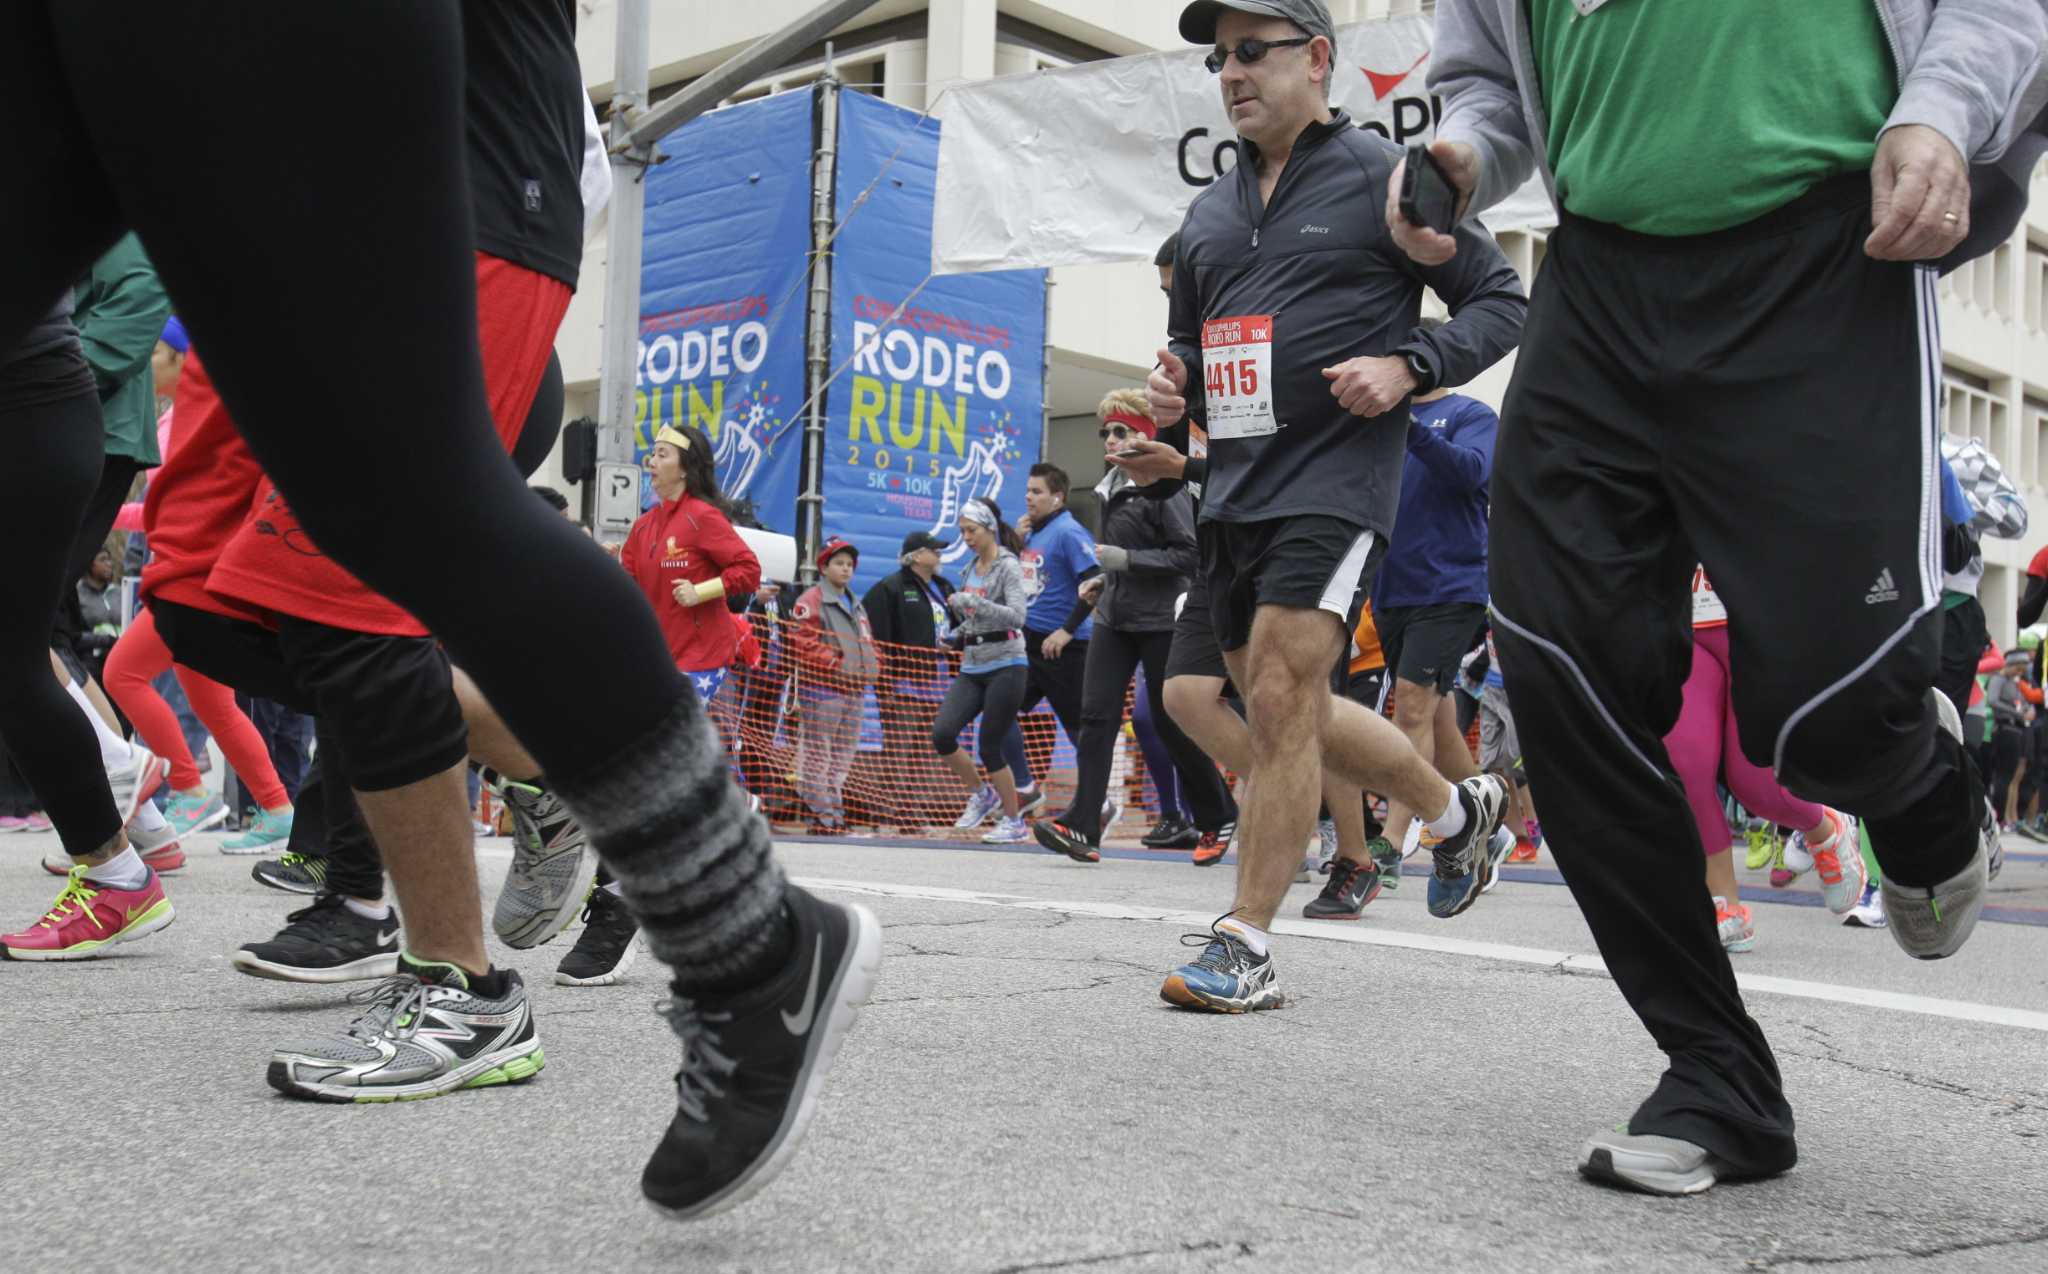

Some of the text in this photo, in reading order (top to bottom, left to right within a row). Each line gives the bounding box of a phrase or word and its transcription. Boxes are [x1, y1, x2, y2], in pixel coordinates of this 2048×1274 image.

[1225, 330, 1241, 343] RUN
[1251, 327, 1268, 341] 10K
[854, 320, 1011, 399] RODEO
[1206, 359, 1258, 399] 4415
[848, 375, 967, 460] RUN
[848, 446, 940, 478] 2015
[867, 472, 933, 496] 5K 10K
